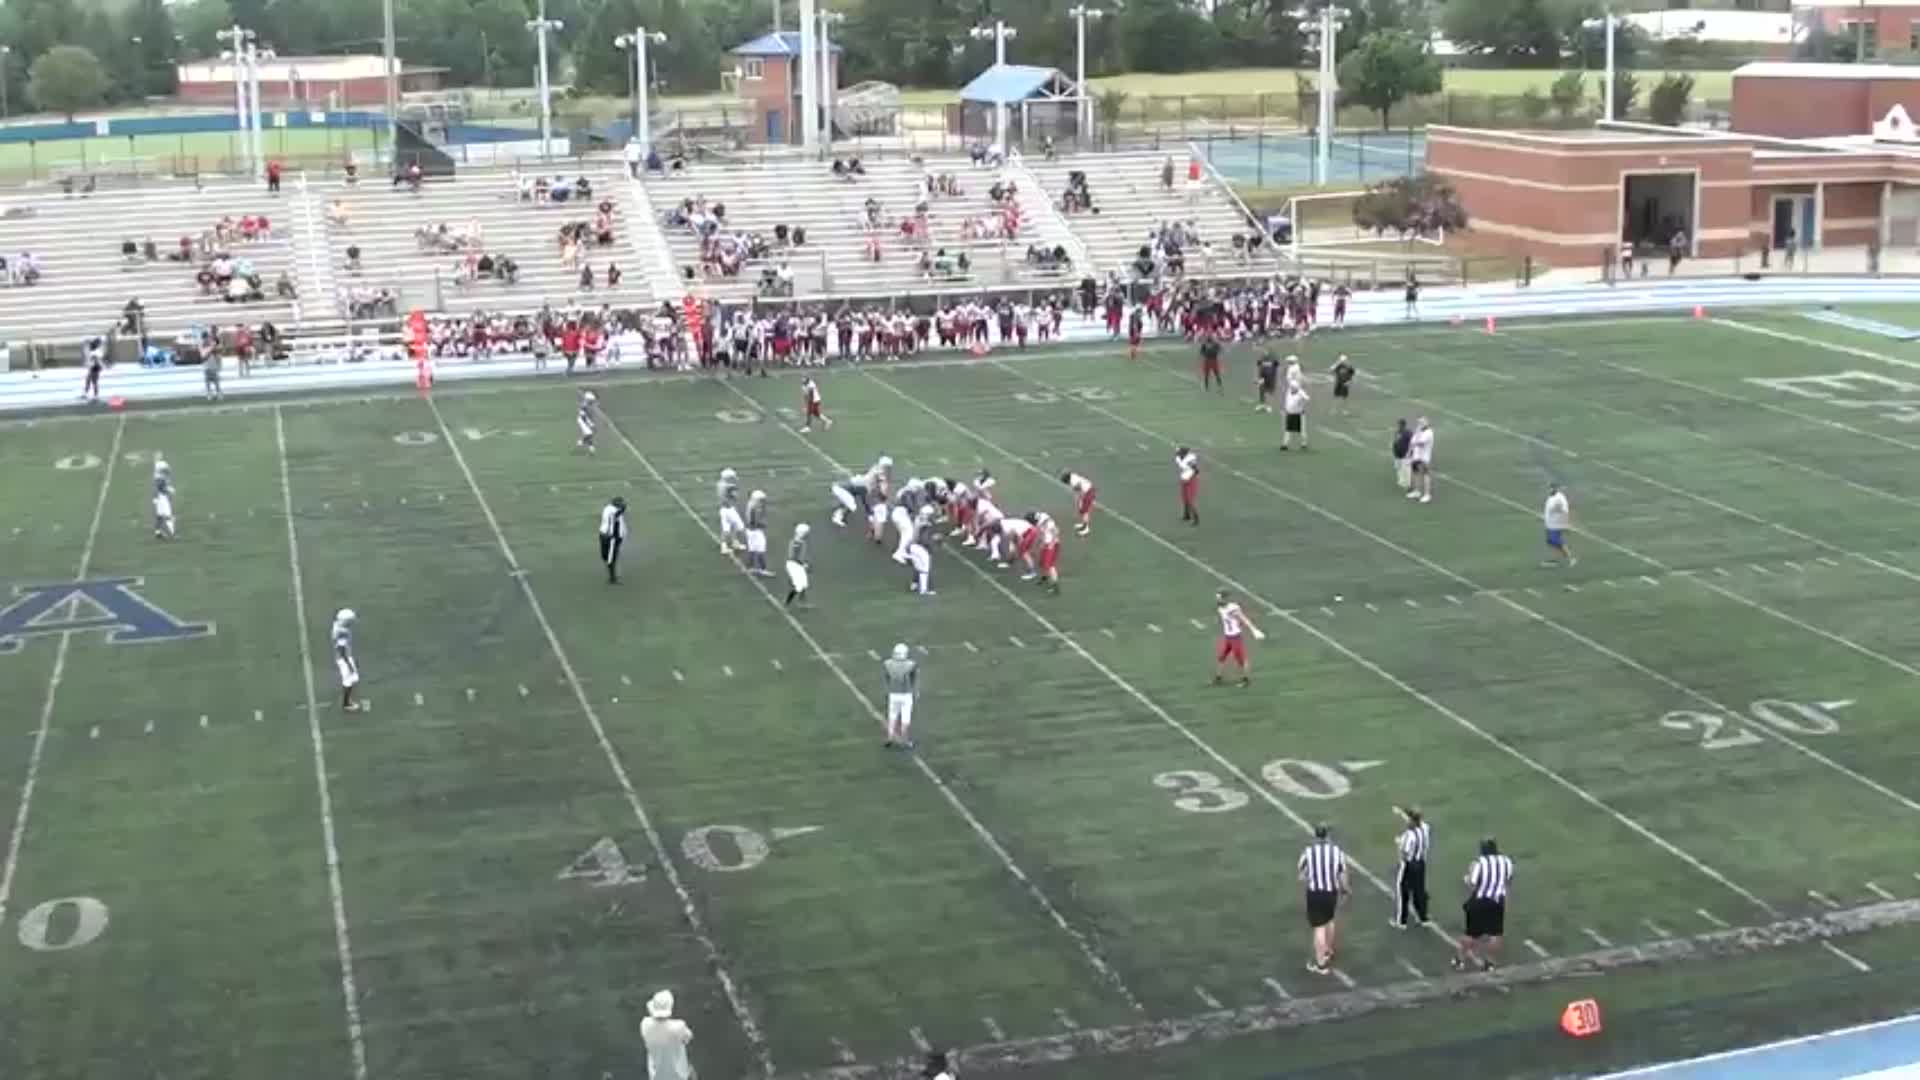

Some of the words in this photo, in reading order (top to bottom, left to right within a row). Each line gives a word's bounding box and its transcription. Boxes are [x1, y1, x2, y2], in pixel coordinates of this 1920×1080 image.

[1659, 699, 1839, 750] 20
[1152, 758, 1351, 812] 30
[557, 824, 769, 887] 40
[1572, 1003, 1597, 1030] 30
